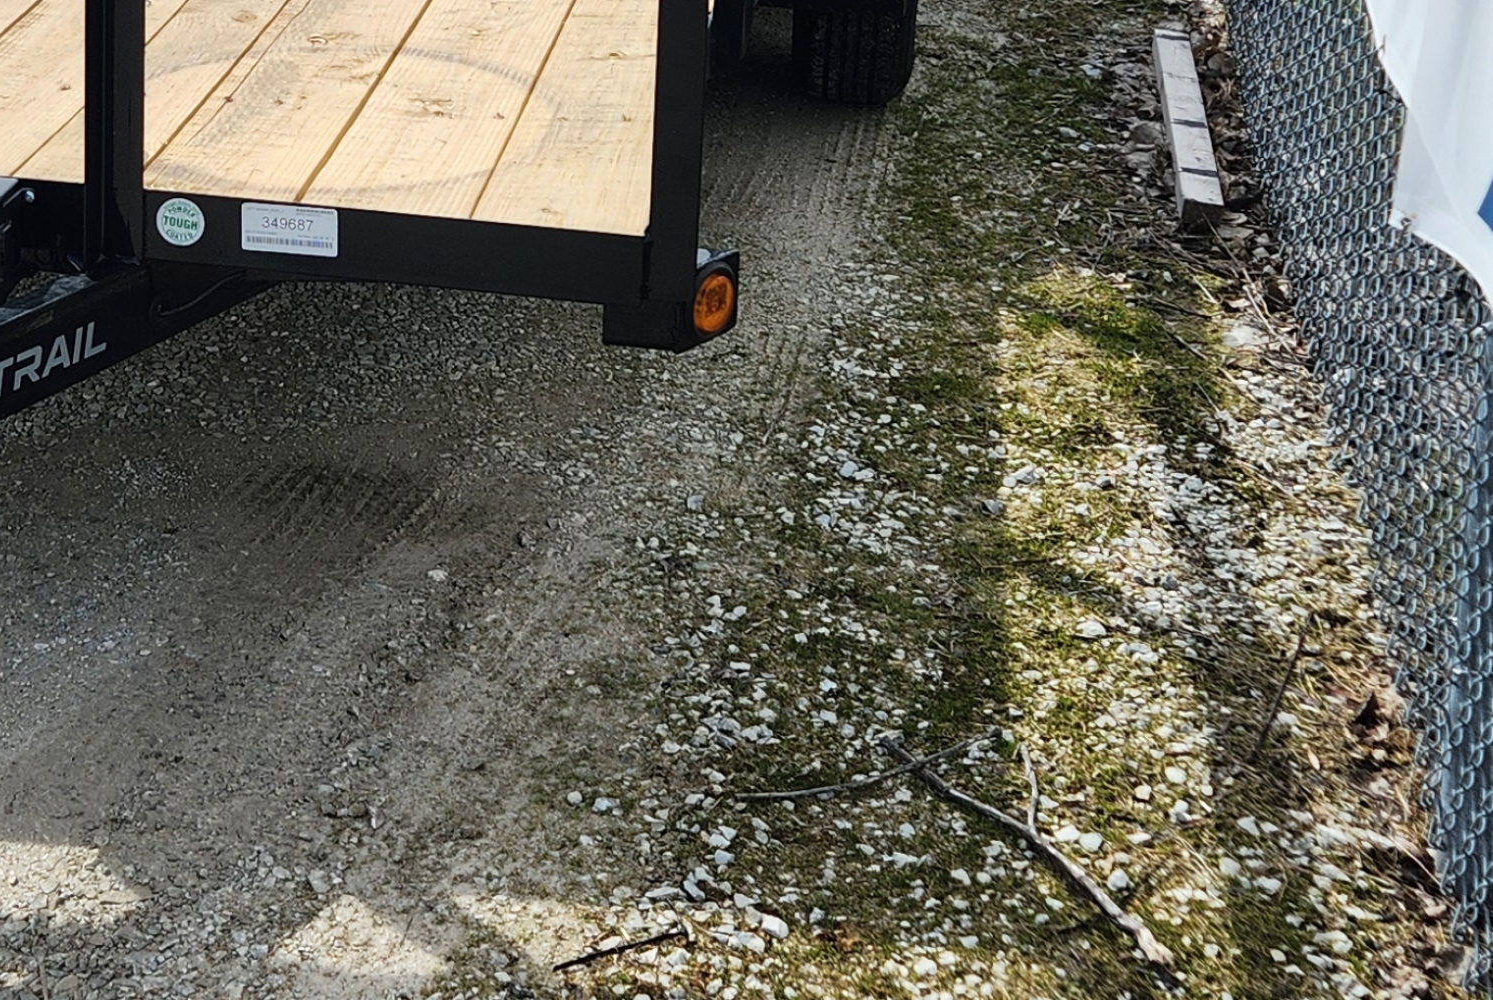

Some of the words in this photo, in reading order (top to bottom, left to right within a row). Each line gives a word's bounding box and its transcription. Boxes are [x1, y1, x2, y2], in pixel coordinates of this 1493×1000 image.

[168, 205, 196, 218] POWDER
[163, 215, 198, 231] TOUGH
[261, 216, 314, 232] 349687
[165, 228, 194, 241] COATED
